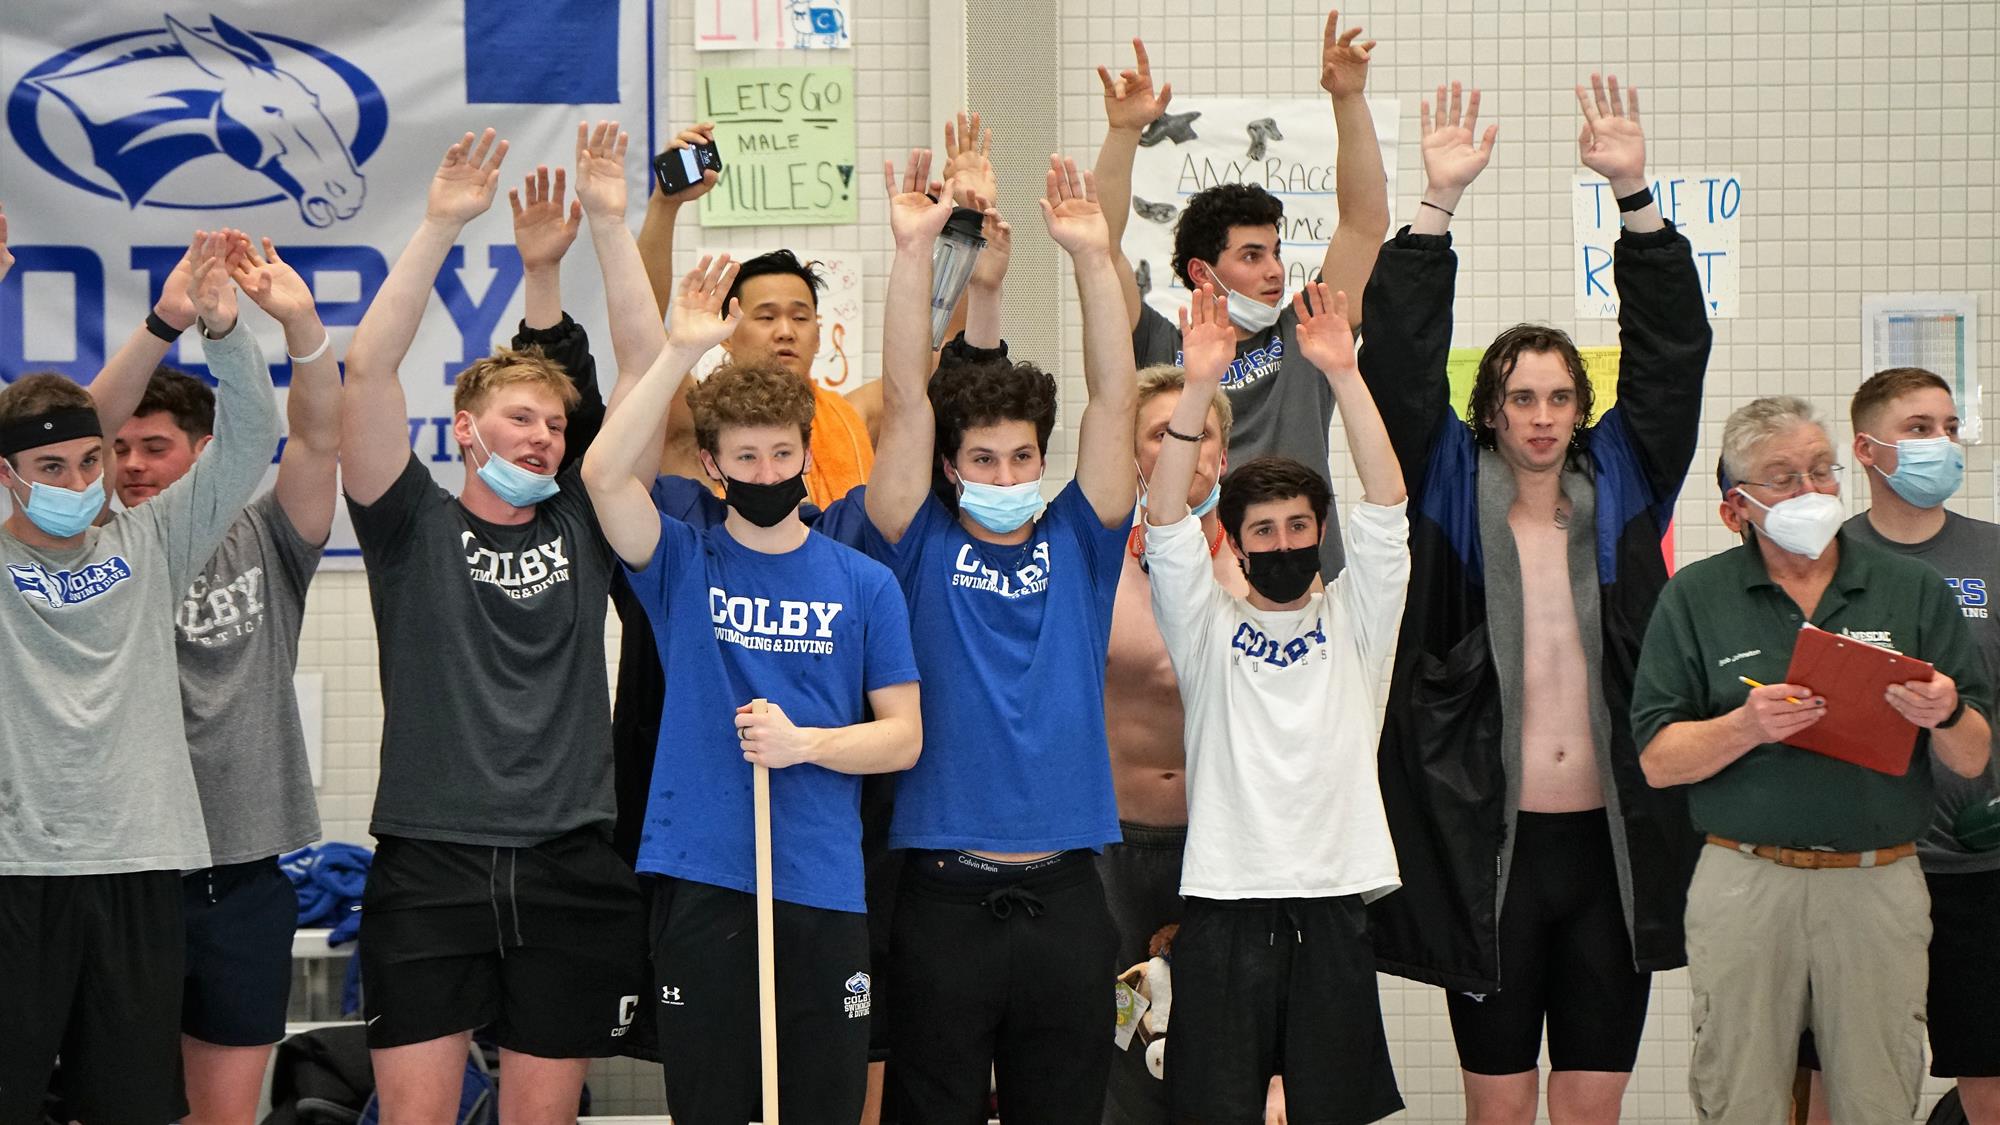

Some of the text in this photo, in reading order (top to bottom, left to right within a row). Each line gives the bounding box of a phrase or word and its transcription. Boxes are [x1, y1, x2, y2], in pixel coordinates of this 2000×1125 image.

[704, 72, 842, 117] LETS GO
[737, 133, 800, 153] MALE
[1178, 152, 1337, 193] ANY RACE
[1699, 177, 1742, 224] TO
[533, 568, 570, 595] DIVIN
[709, 586, 844, 639] COLBY
[714, 626, 835, 656] WIMMING & DIVING
[958, 855, 998, 873] Calvin Klein
